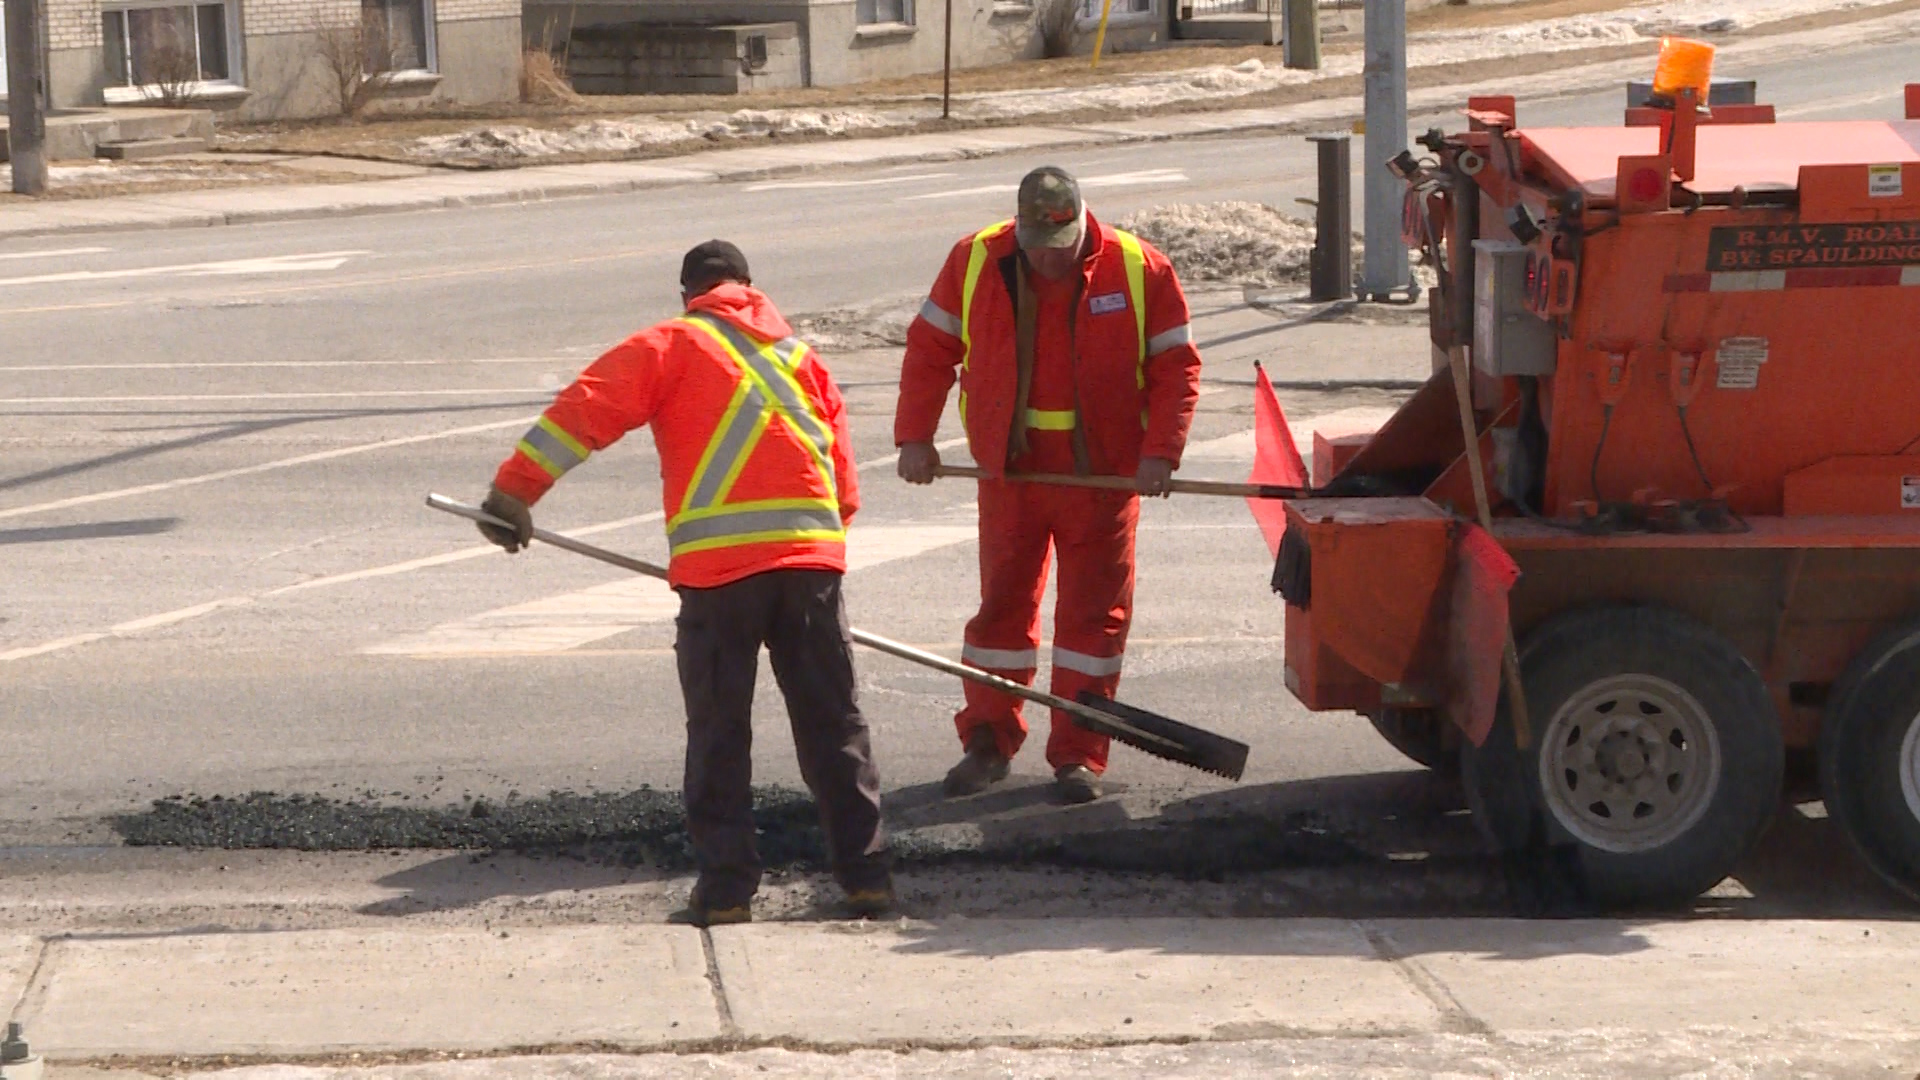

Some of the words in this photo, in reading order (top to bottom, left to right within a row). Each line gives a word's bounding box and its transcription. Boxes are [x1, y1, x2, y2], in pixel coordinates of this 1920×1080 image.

[1736, 227, 1826, 246] R.M.V.
[1721, 248, 1761, 267] BY:
[1768, 245, 1920, 264] SPAULDING
